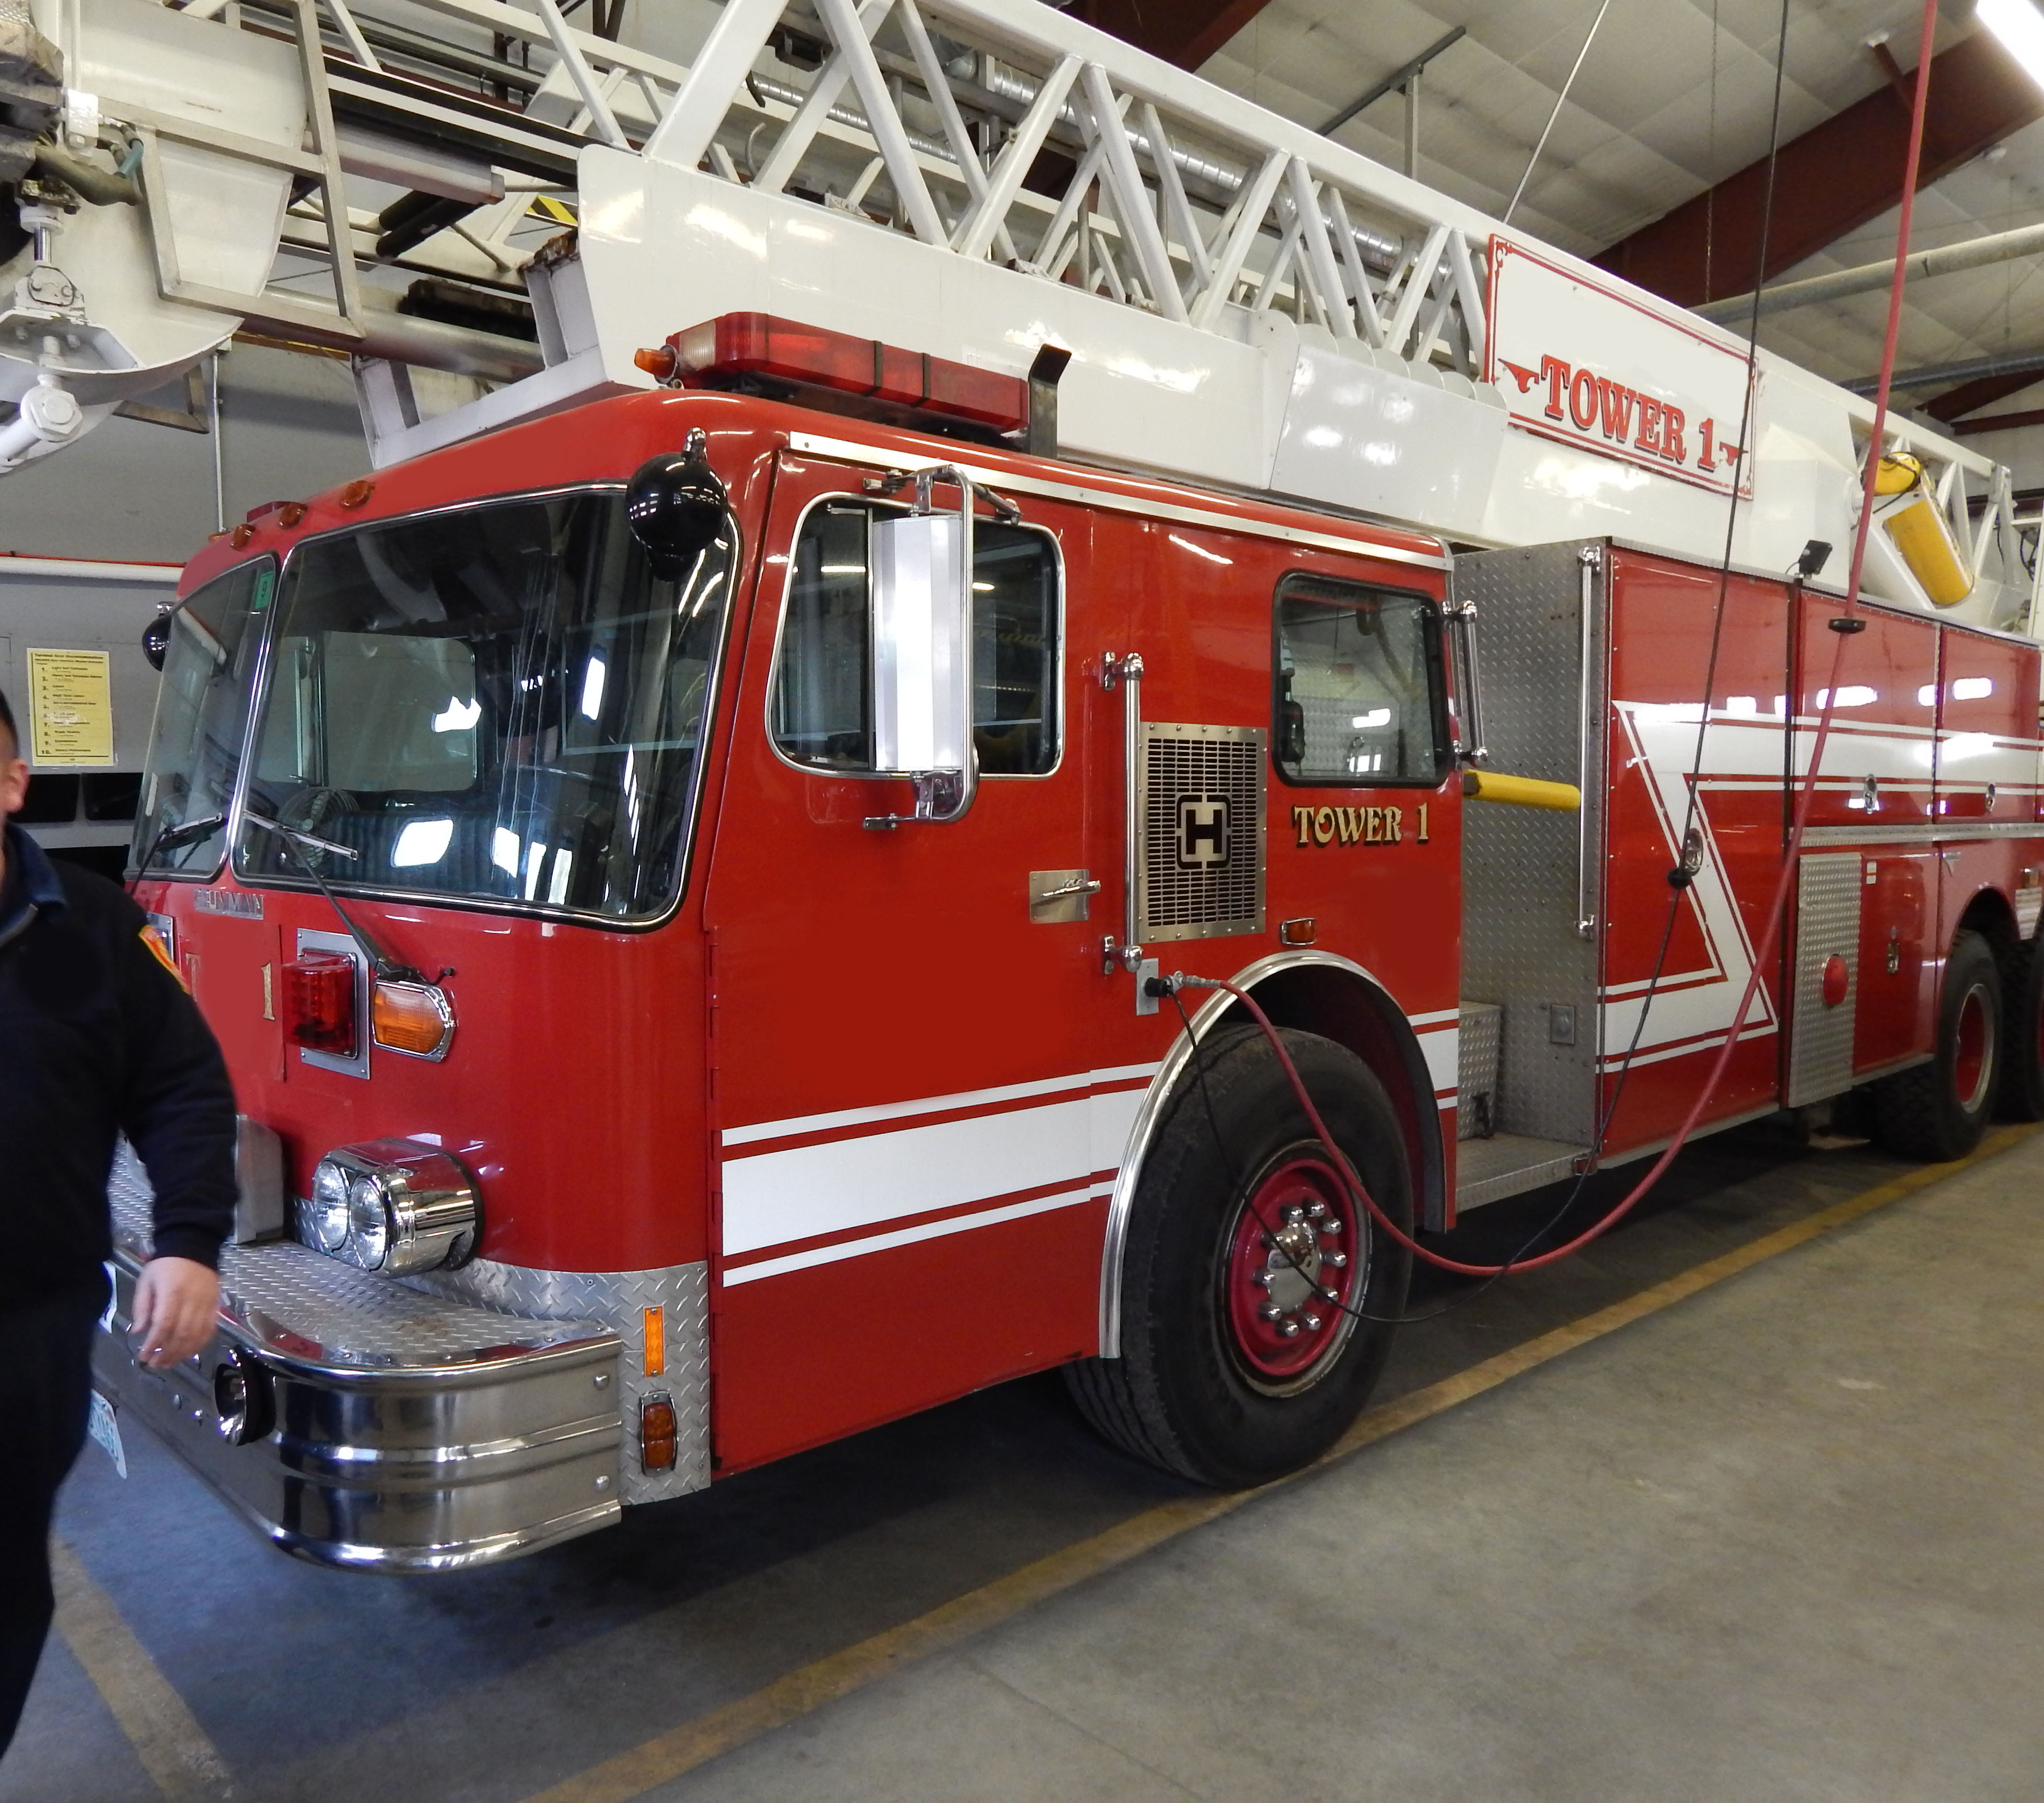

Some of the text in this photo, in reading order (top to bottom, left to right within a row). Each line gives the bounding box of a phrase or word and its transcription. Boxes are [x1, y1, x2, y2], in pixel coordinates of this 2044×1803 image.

[1541, 354, 1716, 472] TOWER 1
[1186, 809, 1222, 855] H
[1291, 802, 1429, 848] TOWER 1
